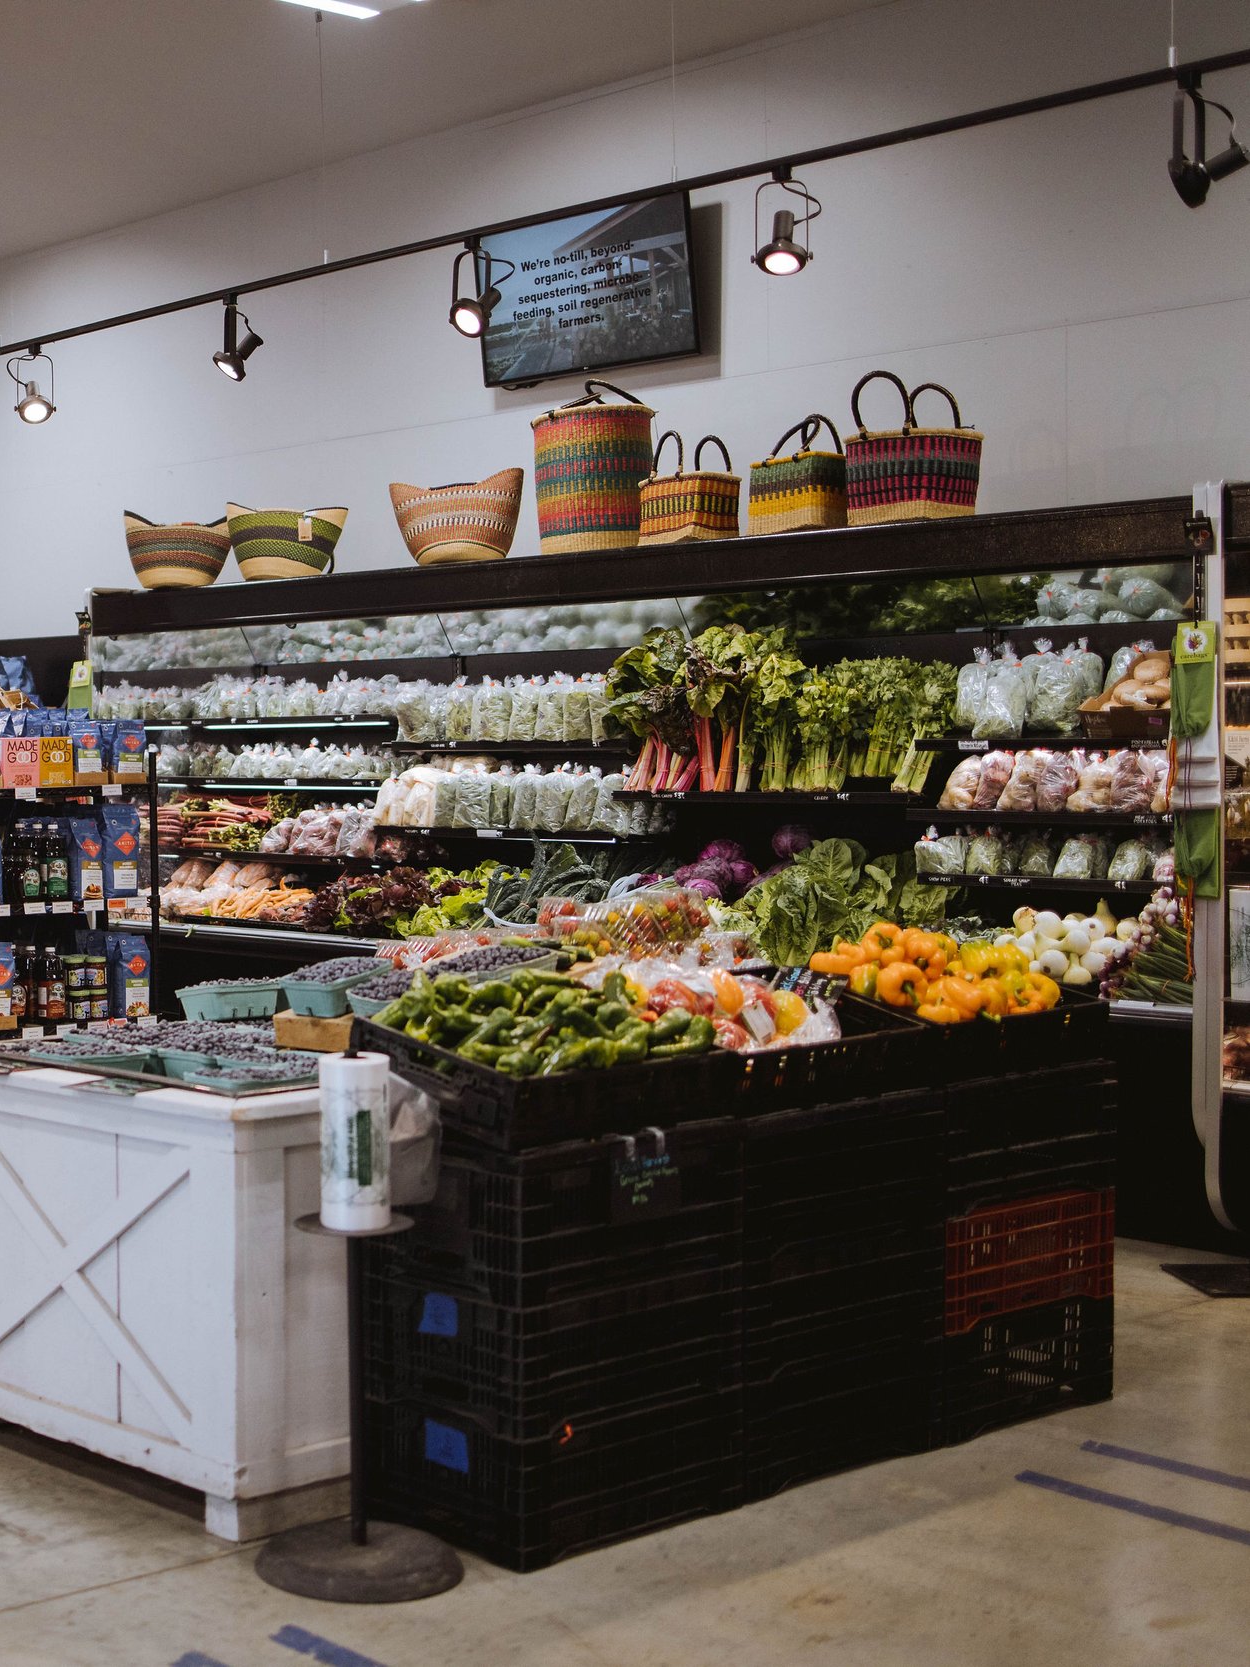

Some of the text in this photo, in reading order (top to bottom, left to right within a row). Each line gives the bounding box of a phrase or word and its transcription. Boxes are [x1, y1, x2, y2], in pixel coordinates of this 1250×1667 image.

[521, 240, 635, 272] We're no-till, beyond-
[534, 261, 623, 286] organic, carbon-
[518, 273, 643, 304] sequestering, microbe-
[513, 287, 651, 322] feeding, soil regenerative
[558, 313, 605, 329] farmers.
[7, 740, 38, 751] MADE
[41, 740, 71, 751] MADE
[7, 751, 38, 763] GOOD
[41, 751, 71, 763] GOOD
